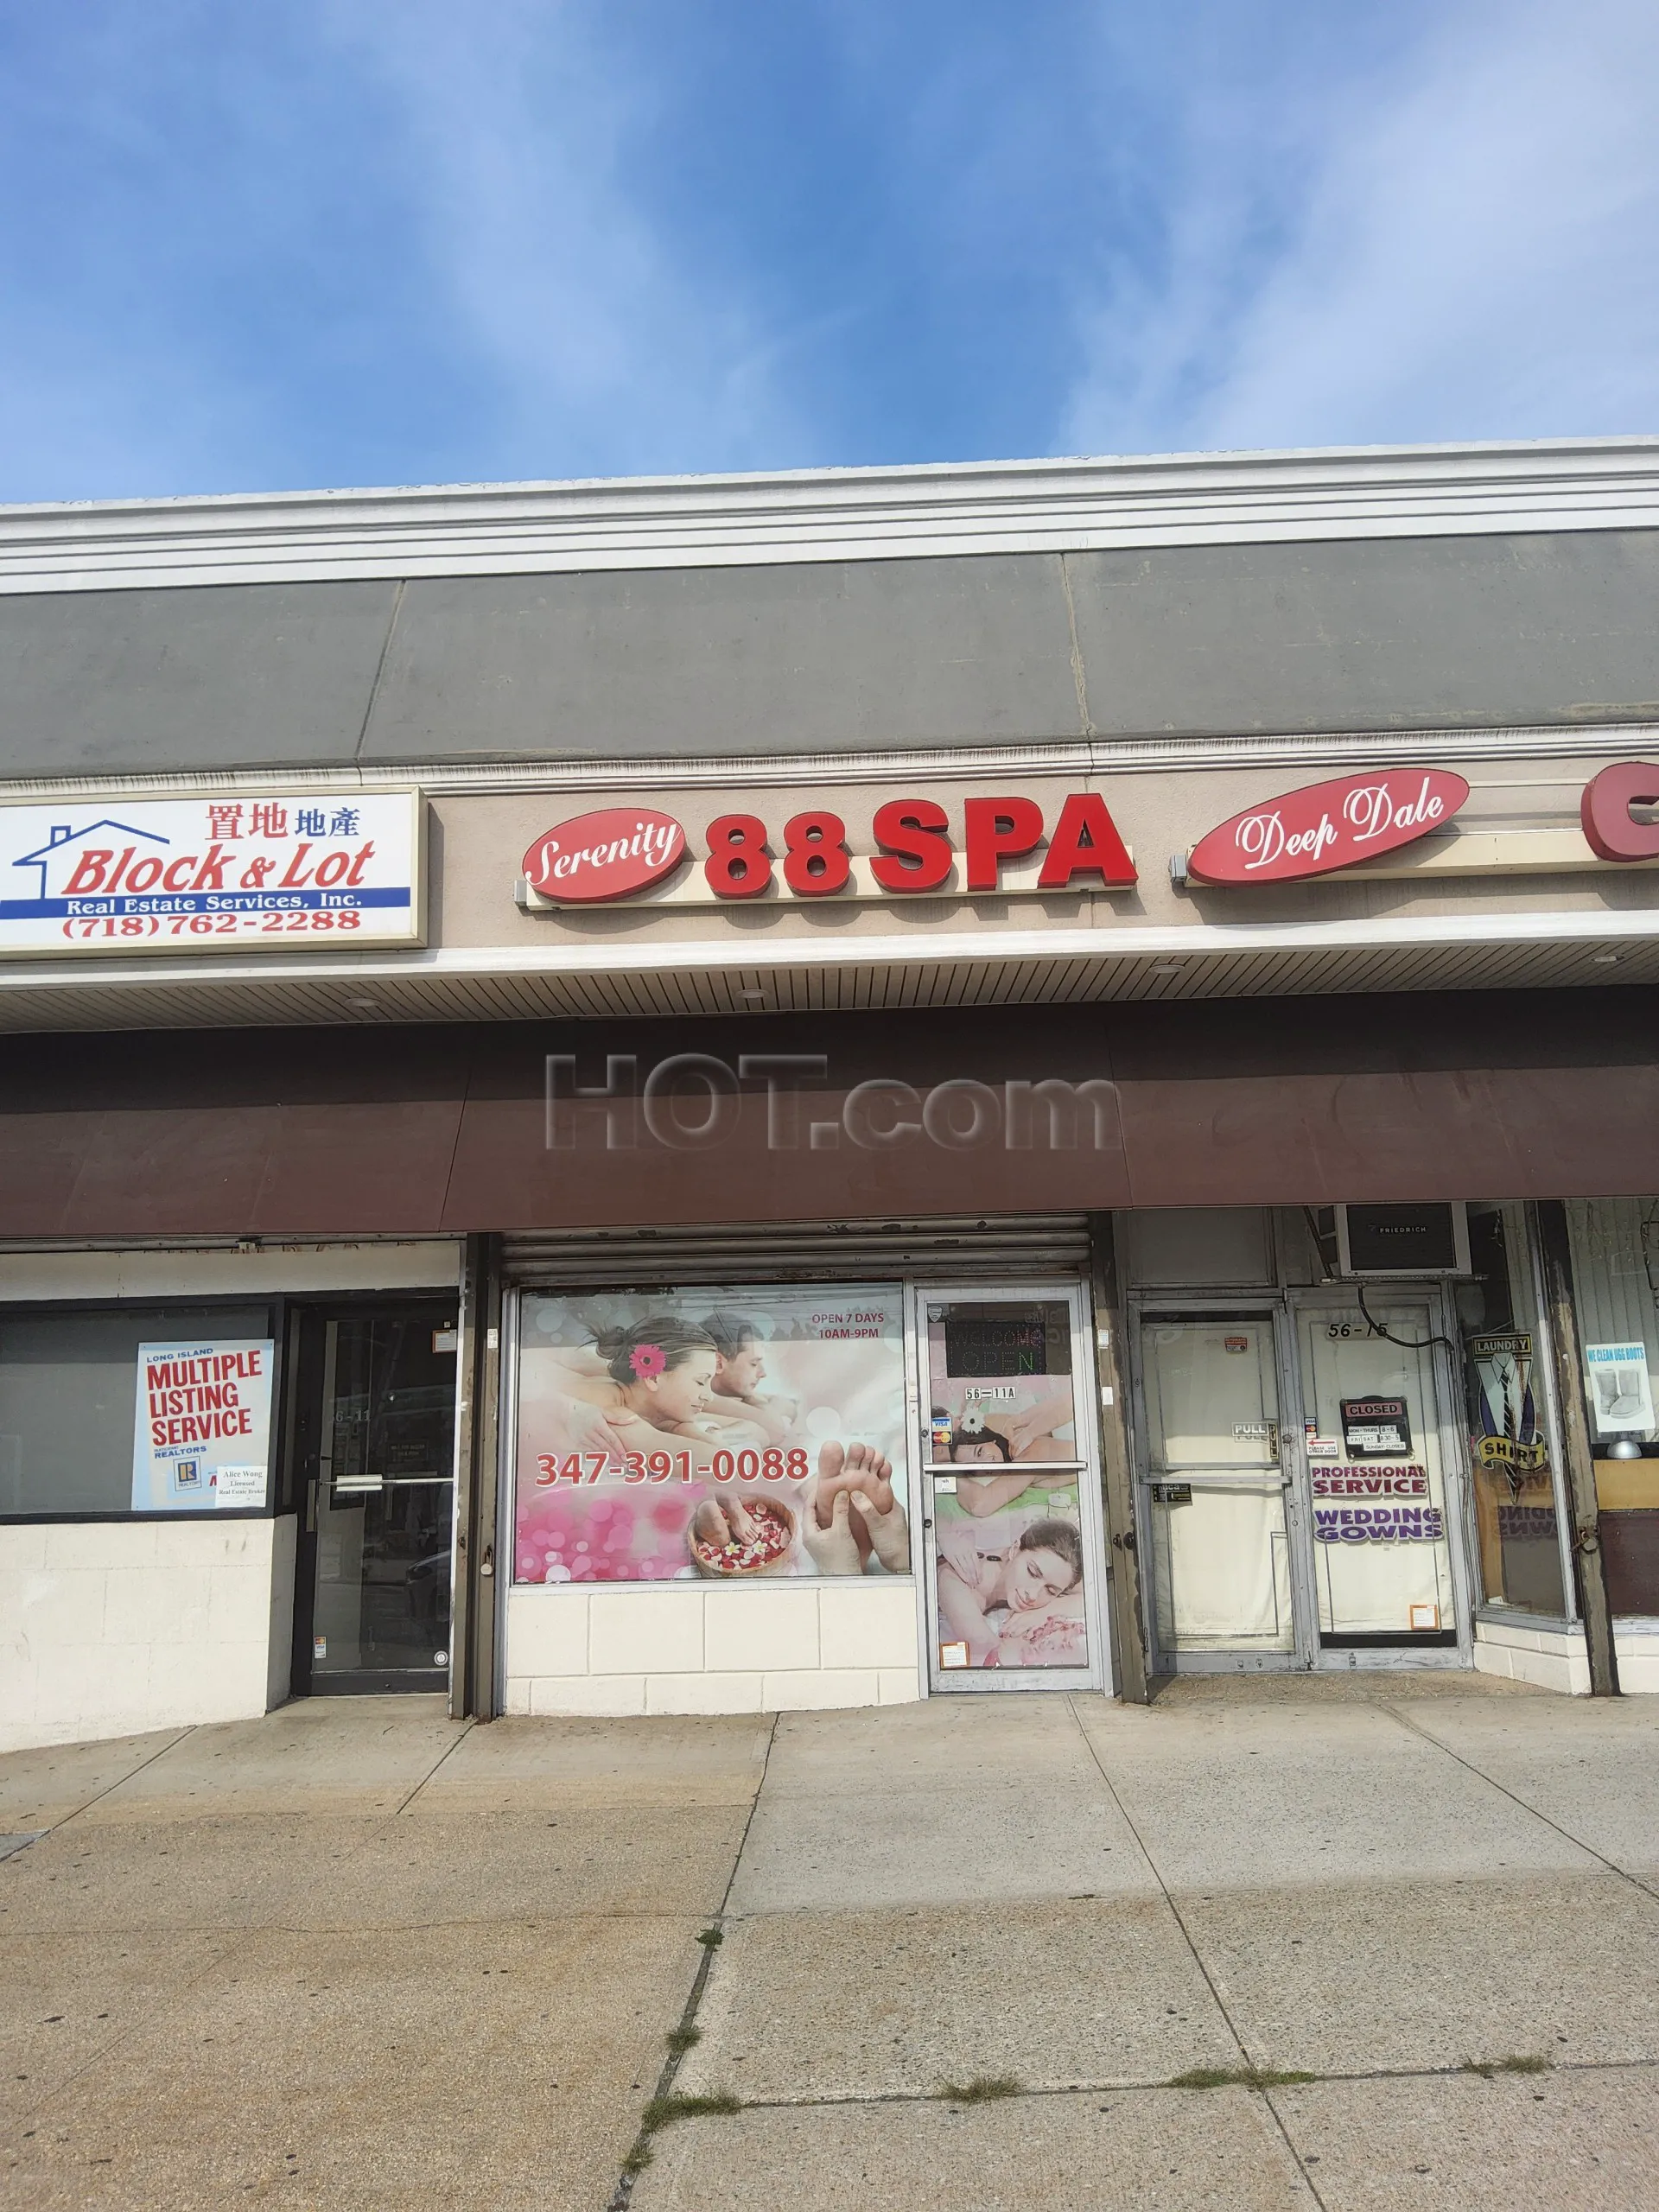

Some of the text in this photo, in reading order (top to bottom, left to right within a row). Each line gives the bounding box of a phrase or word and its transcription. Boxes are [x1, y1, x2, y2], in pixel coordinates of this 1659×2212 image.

[1236, 776, 1444, 870] Deep Dale
[704, 792, 1139, 899] 88 SPA
[525, 821, 680, 887] Serenity
[61, 840, 376, 895] Block & Lot
[67, 893, 362, 915] Real Estate Services, Inc.
[812, 1313, 884, 1324] OPEN 7 DAYS
[819, 1328, 879, 1338] 10AM-9PM
[951, 1328, 1041, 1347] WELCOME
[1477, 1338, 1528, 1352] LAUNDRY
[147, 1348, 213, 1363] LONG ISLAND
[963, 1351, 1033, 1370] OPEN
[1587, 1347, 1645, 1363] WE CLEAN UGG BOOTS
[147, 1350, 262, 1390] MULTIPLE
[149, 1382, 238, 1419] LISTING
[966, 1388, 1014, 1399] 56-11A
[1350, 1404, 1398, 1415] CLOSED
[151, 1408, 252, 1446] SERVICE
[1235, 1424, 1266, 1433] PULL
[155, 1446, 207, 1459] REALTORS
[1484, 1442, 1538, 1464] SHIRT
[242, 1470, 263, 1478] Wong
[534, 1447, 810, 1487] 347-391-0088
[1312, 1465, 1426, 1478] PROFESSIONAL
[1312, 1478, 1427, 1494] SERVICE
[1314, 1508, 1442, 1525] WEDDING
[1315, 1525, 1444, 1540] GOWNS
